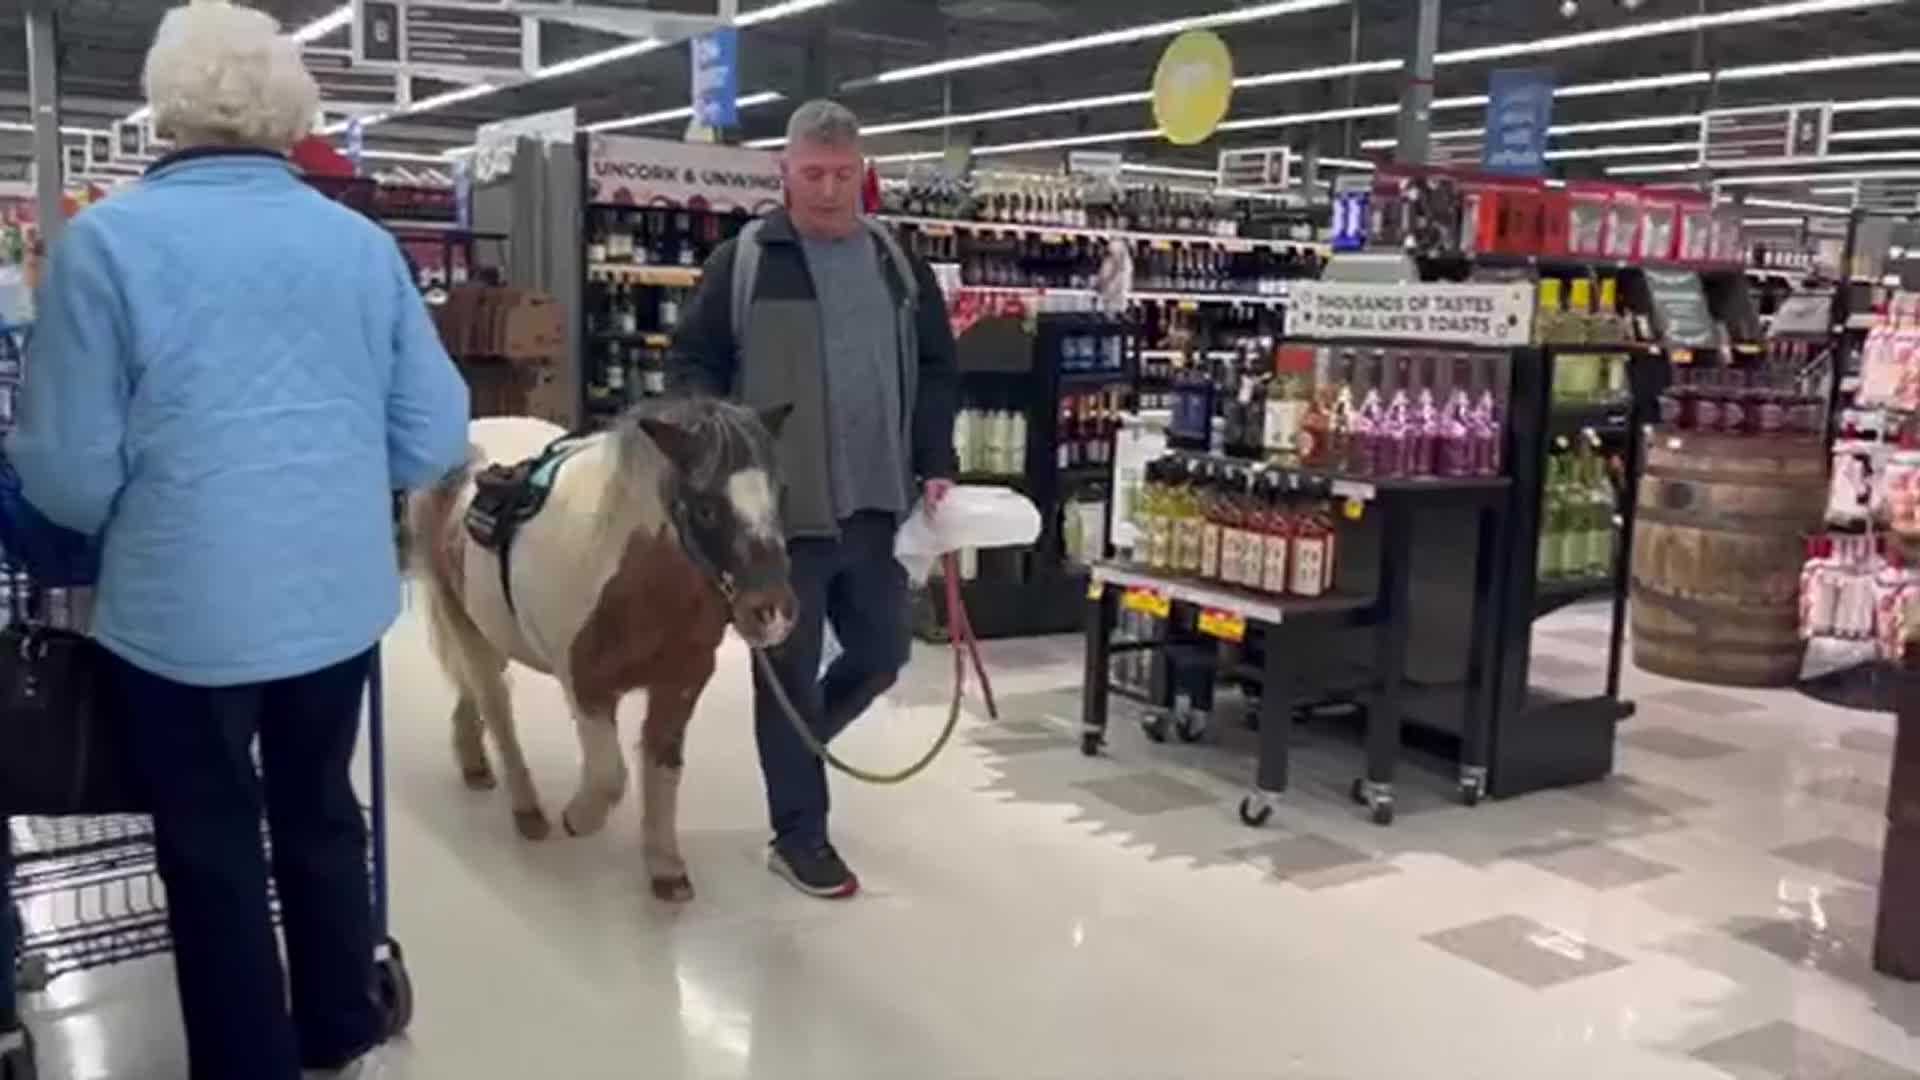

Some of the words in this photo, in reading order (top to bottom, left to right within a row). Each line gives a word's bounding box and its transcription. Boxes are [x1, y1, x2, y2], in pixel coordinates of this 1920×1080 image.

[594, 161, 677, 182] UNCORK
[684, 168, 696, 183] &
[1317, 294, 1403, 311] THOUSANDS
[1408, 295, 1430, 311] OF
[1434, 295, 1494, 313] TASTES
[1317, 313, 1344, 328] FOR
[1350, 314, 1374, 329] ALL
[1378, 315, 1423, 331] LIFE'S
[1428, 315, 1491, 333] TOASTS
